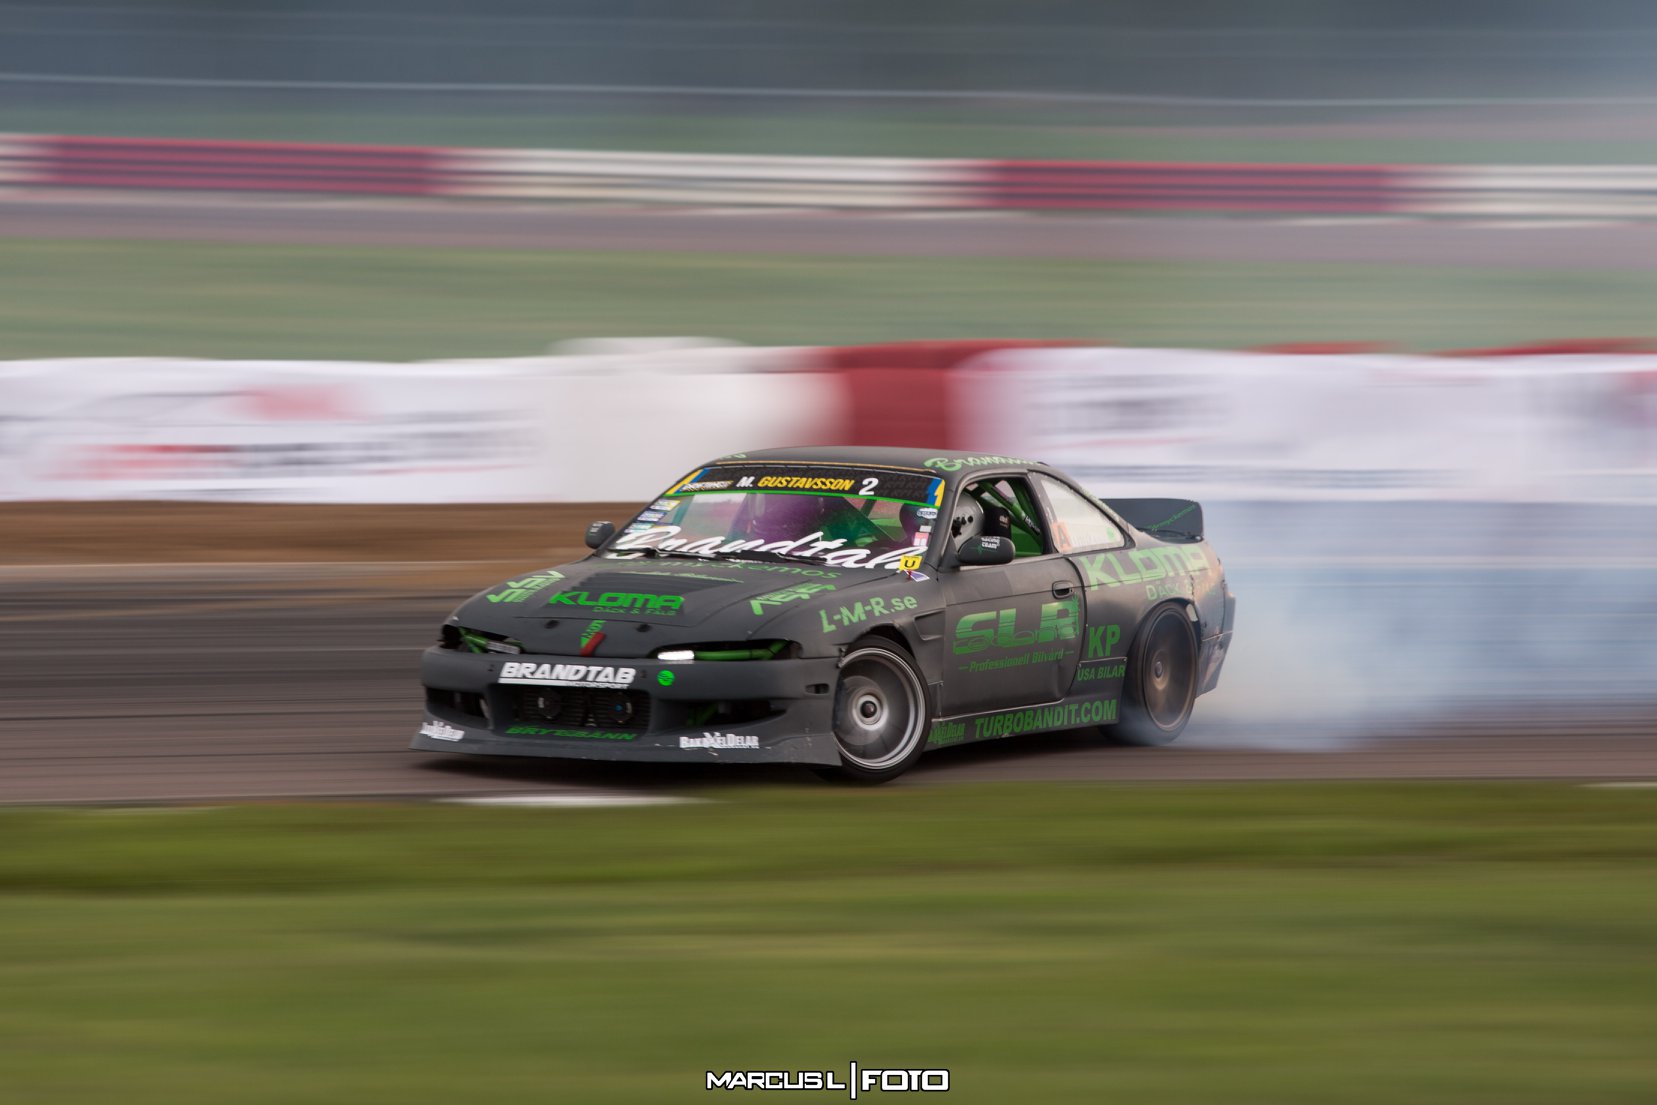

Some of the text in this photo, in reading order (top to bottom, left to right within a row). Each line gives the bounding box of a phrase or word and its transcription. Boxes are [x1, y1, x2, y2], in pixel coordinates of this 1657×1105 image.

[736, 476, 755, 488] M.
[758, 476, 855, 491] GUSTAVSSON
[858, 478, 879, 496] 2
[904, 559, 916, 568] U
[1078, 545, 1212, 591] KLOMA
[549, 591, 685, 609] KLOMA
[818, 595, 918, 633] L-M-R.se
[954, 601, 1079, 655] SLR
[1088, 624, 1121, 658] KP
[500, 662, 636, 684] BRANDTAB
[1076, 665, 1126, 681] USA BILAR
[975, 699, 1117, 739] TURBOBANDIT.COM
